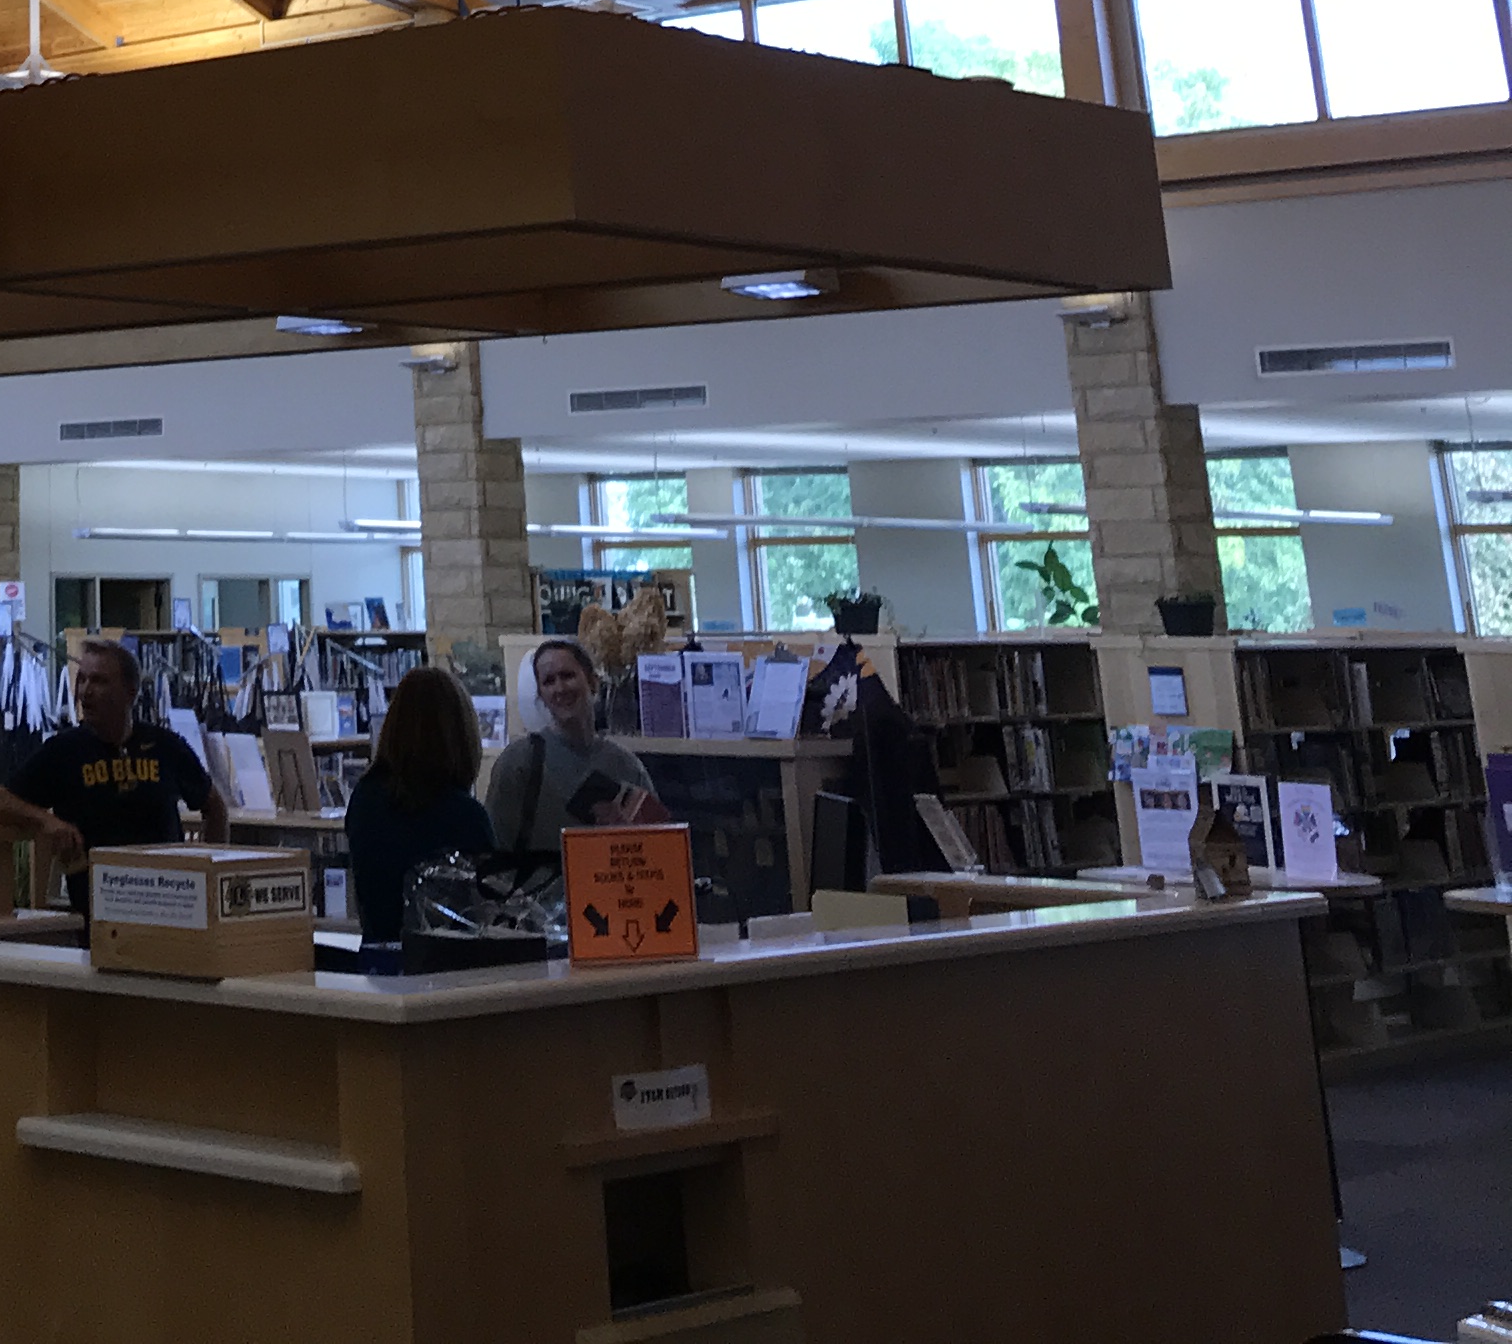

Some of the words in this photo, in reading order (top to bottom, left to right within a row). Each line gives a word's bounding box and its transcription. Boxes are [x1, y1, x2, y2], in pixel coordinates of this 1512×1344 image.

[82, 759, 109, 787] GO
[112, 757, 161, 783] BLUE
[102, 872, 155, 888] Eyeglasses
[158, 875, 196, 892] Recycle
[255, 887, 269, 904] WE
[271, 885, 301, 903] SERVE
